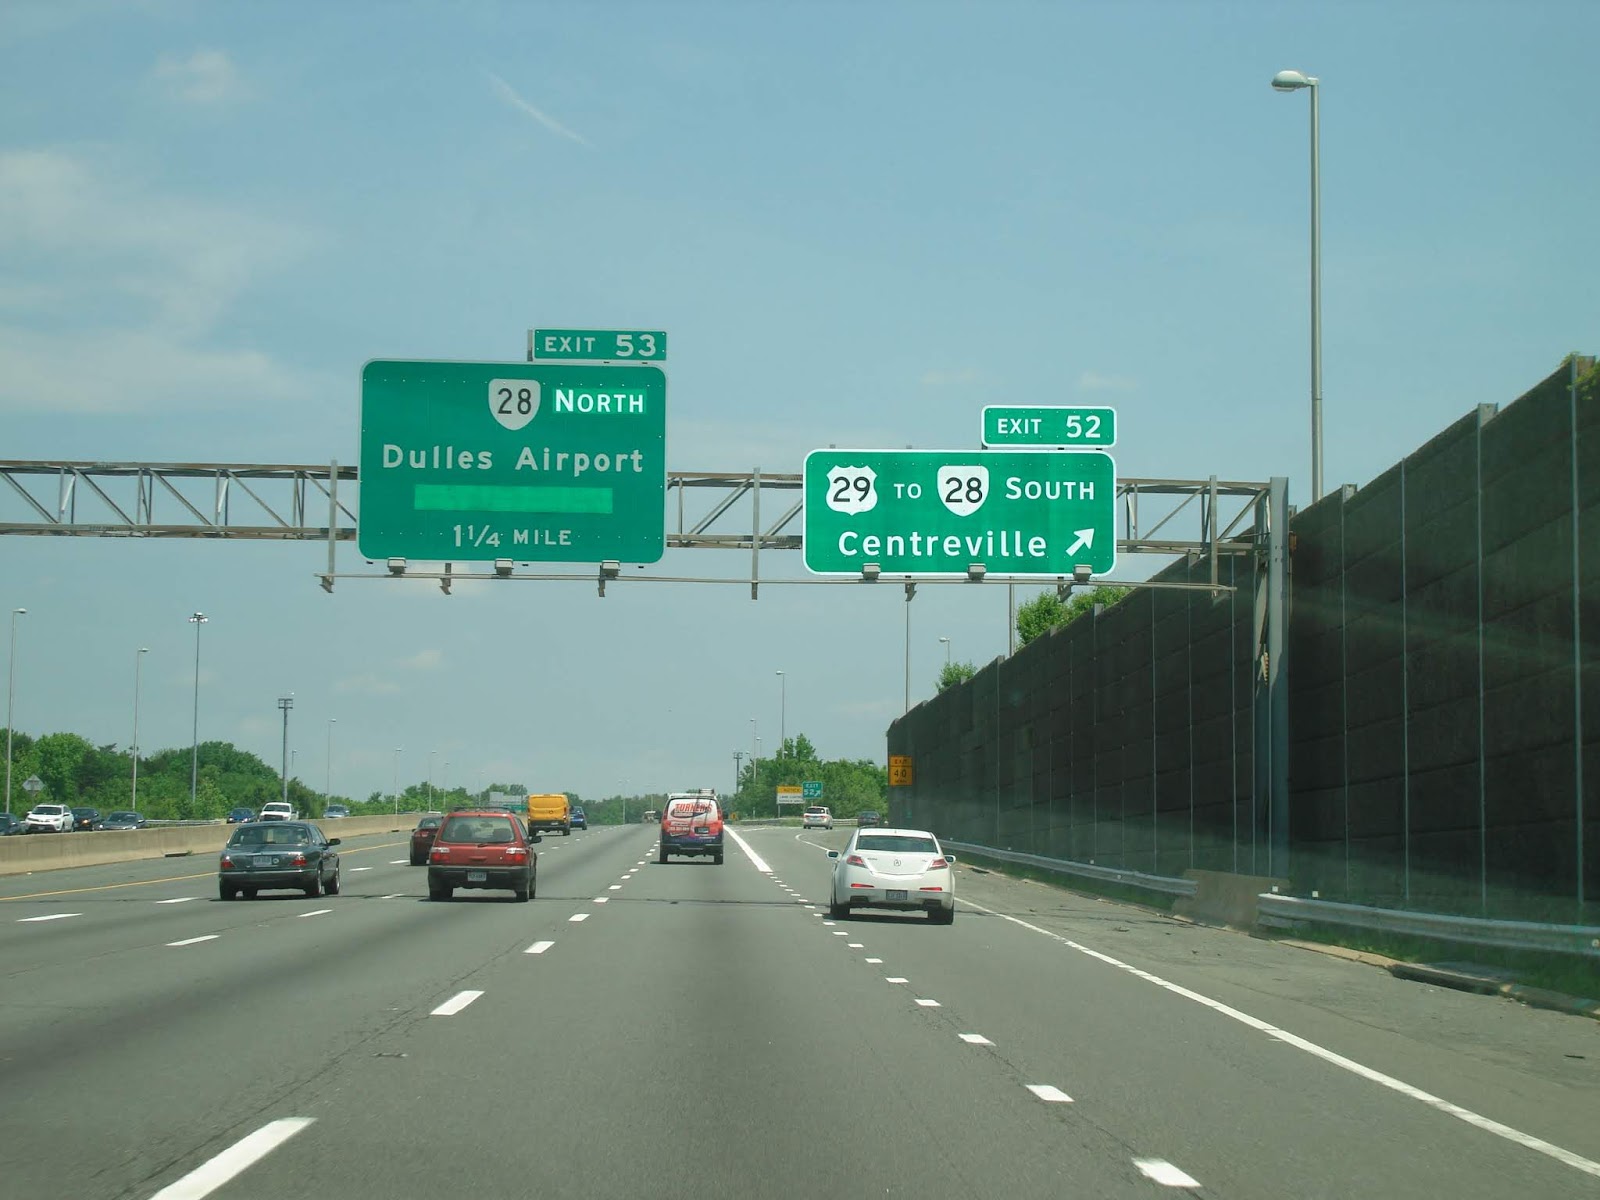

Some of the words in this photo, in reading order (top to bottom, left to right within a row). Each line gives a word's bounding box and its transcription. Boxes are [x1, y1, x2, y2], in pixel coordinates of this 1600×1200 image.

[544, 336, 596, 353] EXIT
[615, 334, 657, 357] 53
[497, 387, 533, 415] 28
[555, 389, 644, 413] NORTH
[997, 418, 1042, 435] EXIT
[1066, 415, 1101, 439] 52
[383, 444, 494, 470] Dulles
[514, 446, 644, 477] Airport
[832, 476, 871, 503] 29
[893, 483, 922, 499] TO
[944, 477, 983, 504] 28
[1005, 476, 1095, 500] SOUTH
[513, 529, 573, 546] MILE
[838, 530, 1047, 557] Centreville
[894, 769, 907, 778] 40
[803, 788, 815, 796] 52
